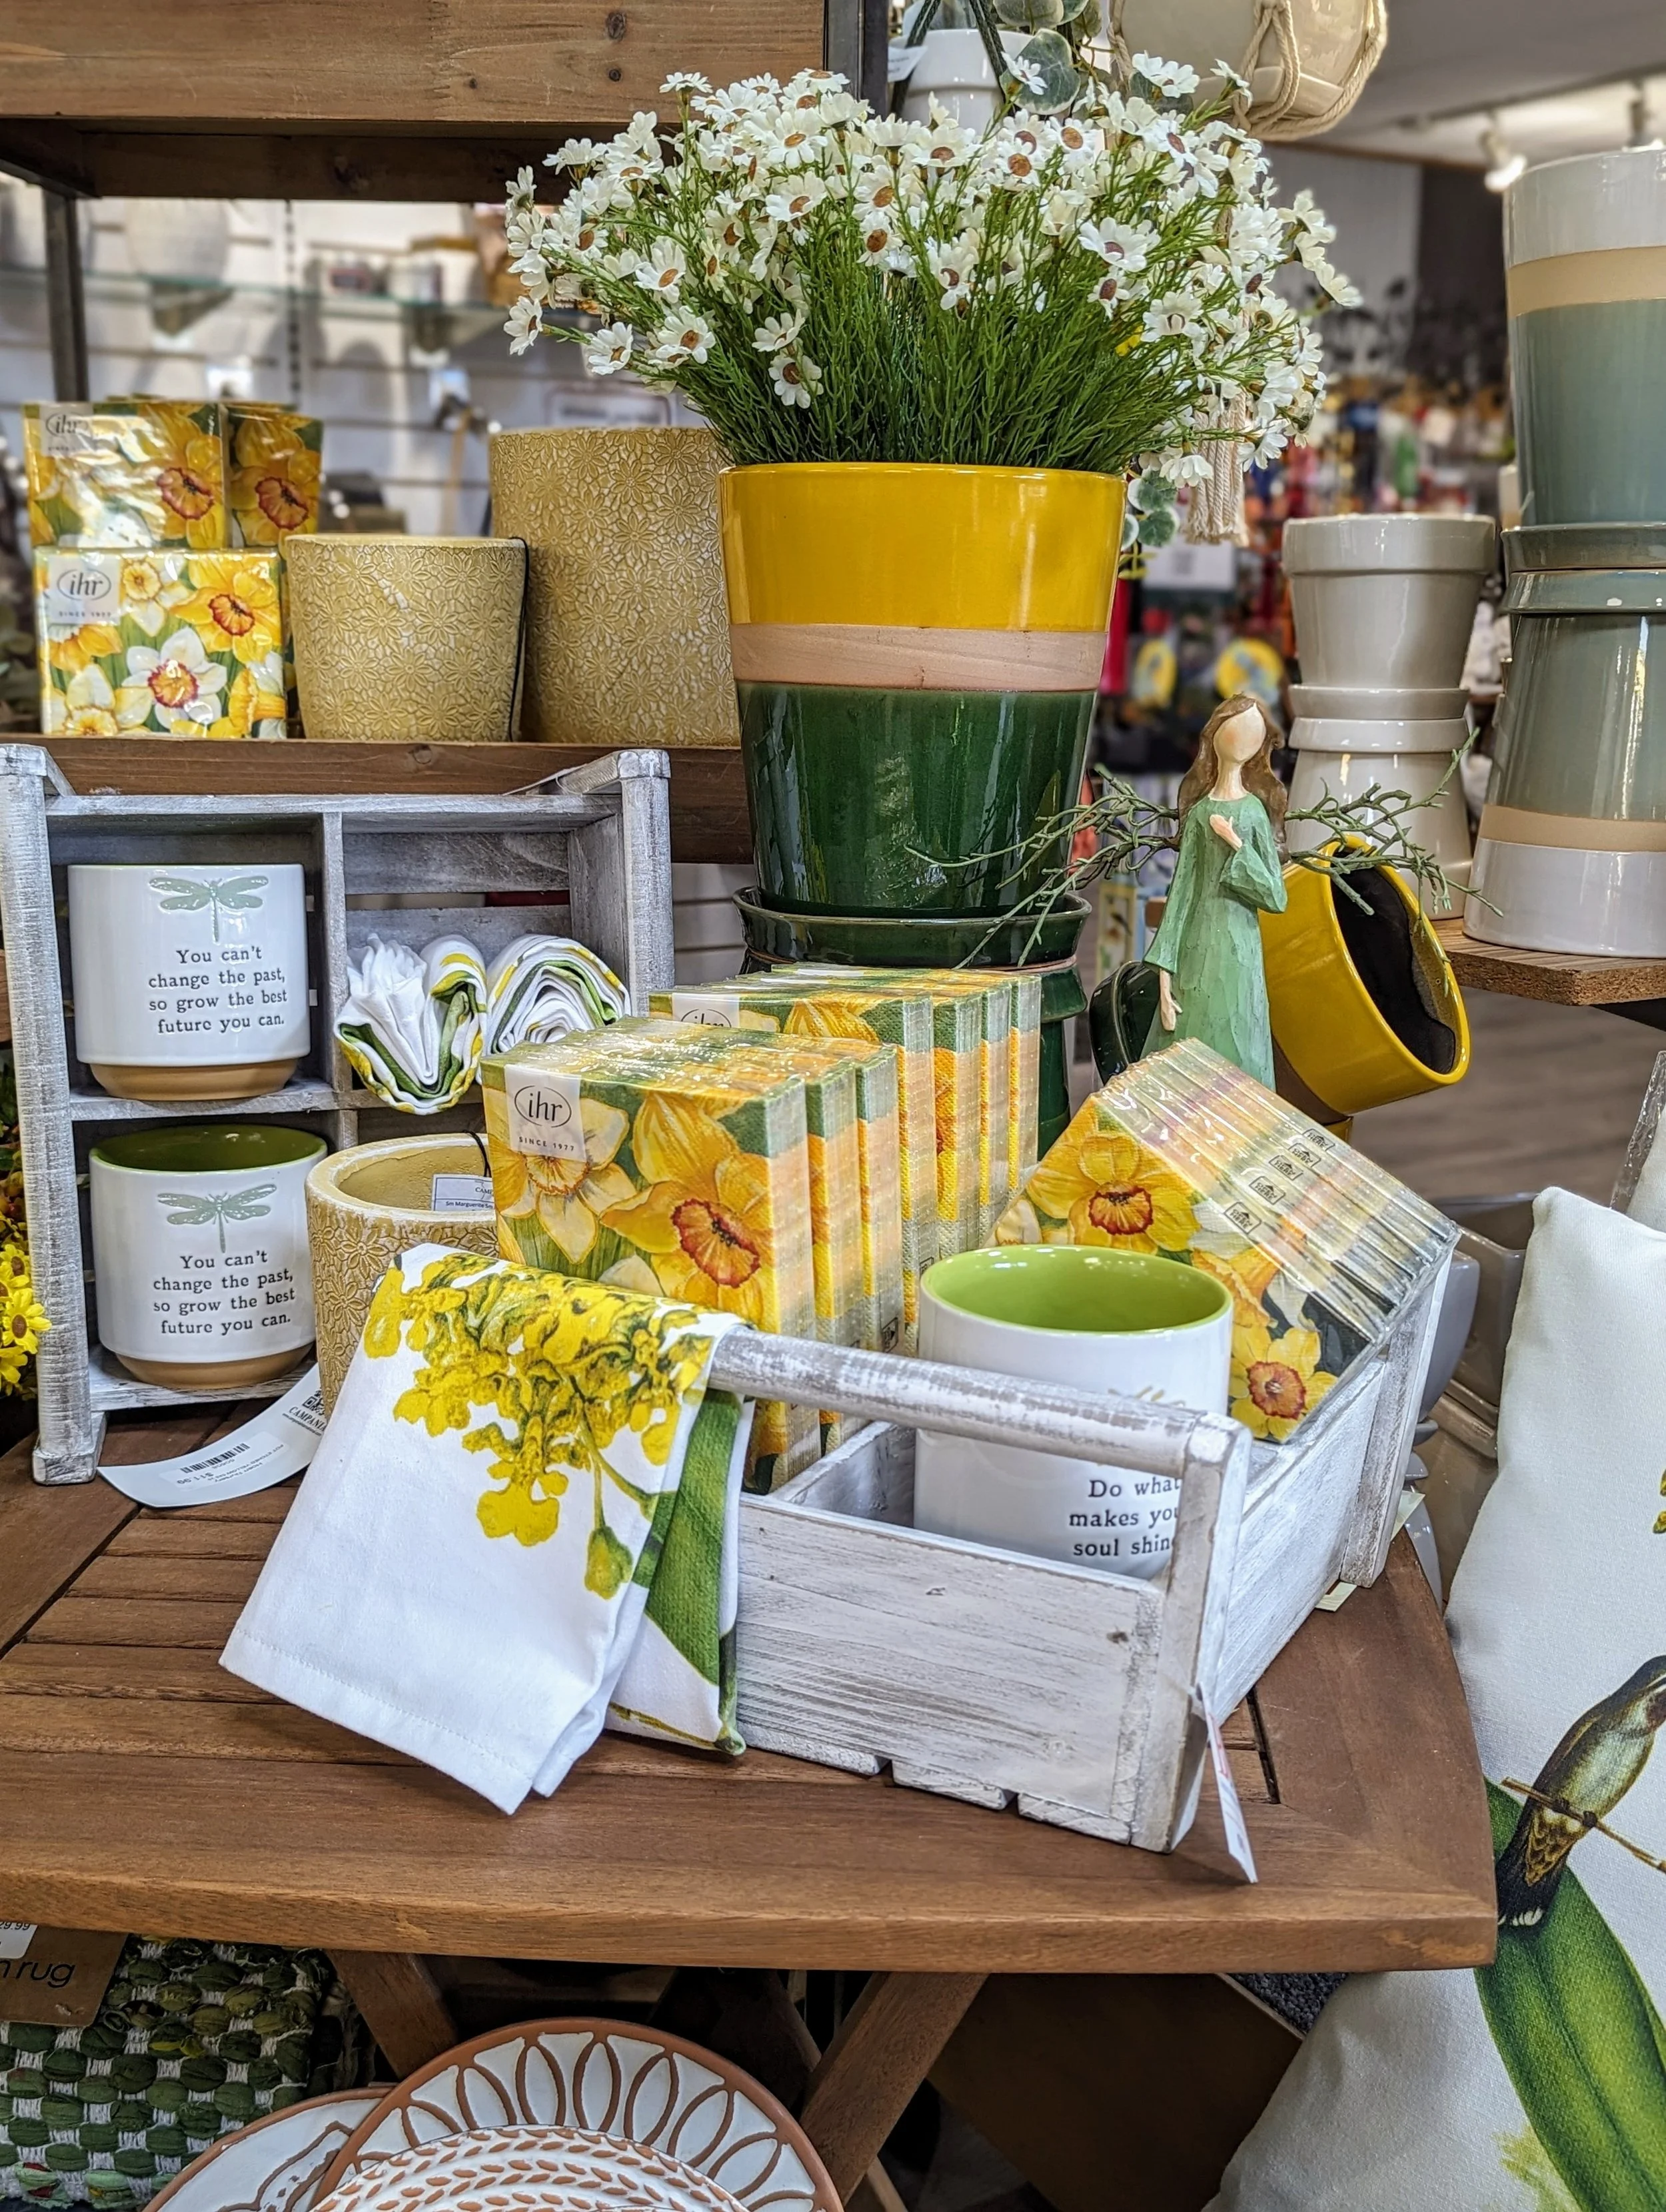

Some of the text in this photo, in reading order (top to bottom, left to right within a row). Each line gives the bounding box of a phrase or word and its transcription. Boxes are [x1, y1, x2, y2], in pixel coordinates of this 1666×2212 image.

[69, 572, 103, 596] ihr
[176, 945, 262, 964] You can't
[149, 968, 285, 989] change the past,
[149, 990, 287, 1013] so grow the best
[158, 1015, 285, 1033] future you can.
[528, 1091, 562, 1121] ihr
[519, 1137, 574, 1151] SINCE 1977
[180, 1251, 267, 1269] You can't
[153, 1268, 293, 1294] change the past,
[153, 1288, 295, 1316] so grow the best
[161, 1314, 291, 1336] future you can.
[289, 1406, 327, 1432] CAMPANIA
[177, 1472, 214, 1484] $11.99
[1088, 1476, 1180, 1497] Do what
[1069, 1508, 1140, 1527] makes
[1073, 1534, 1174, 1556] soul shin
[15, 1961, 75, 1988] rug
